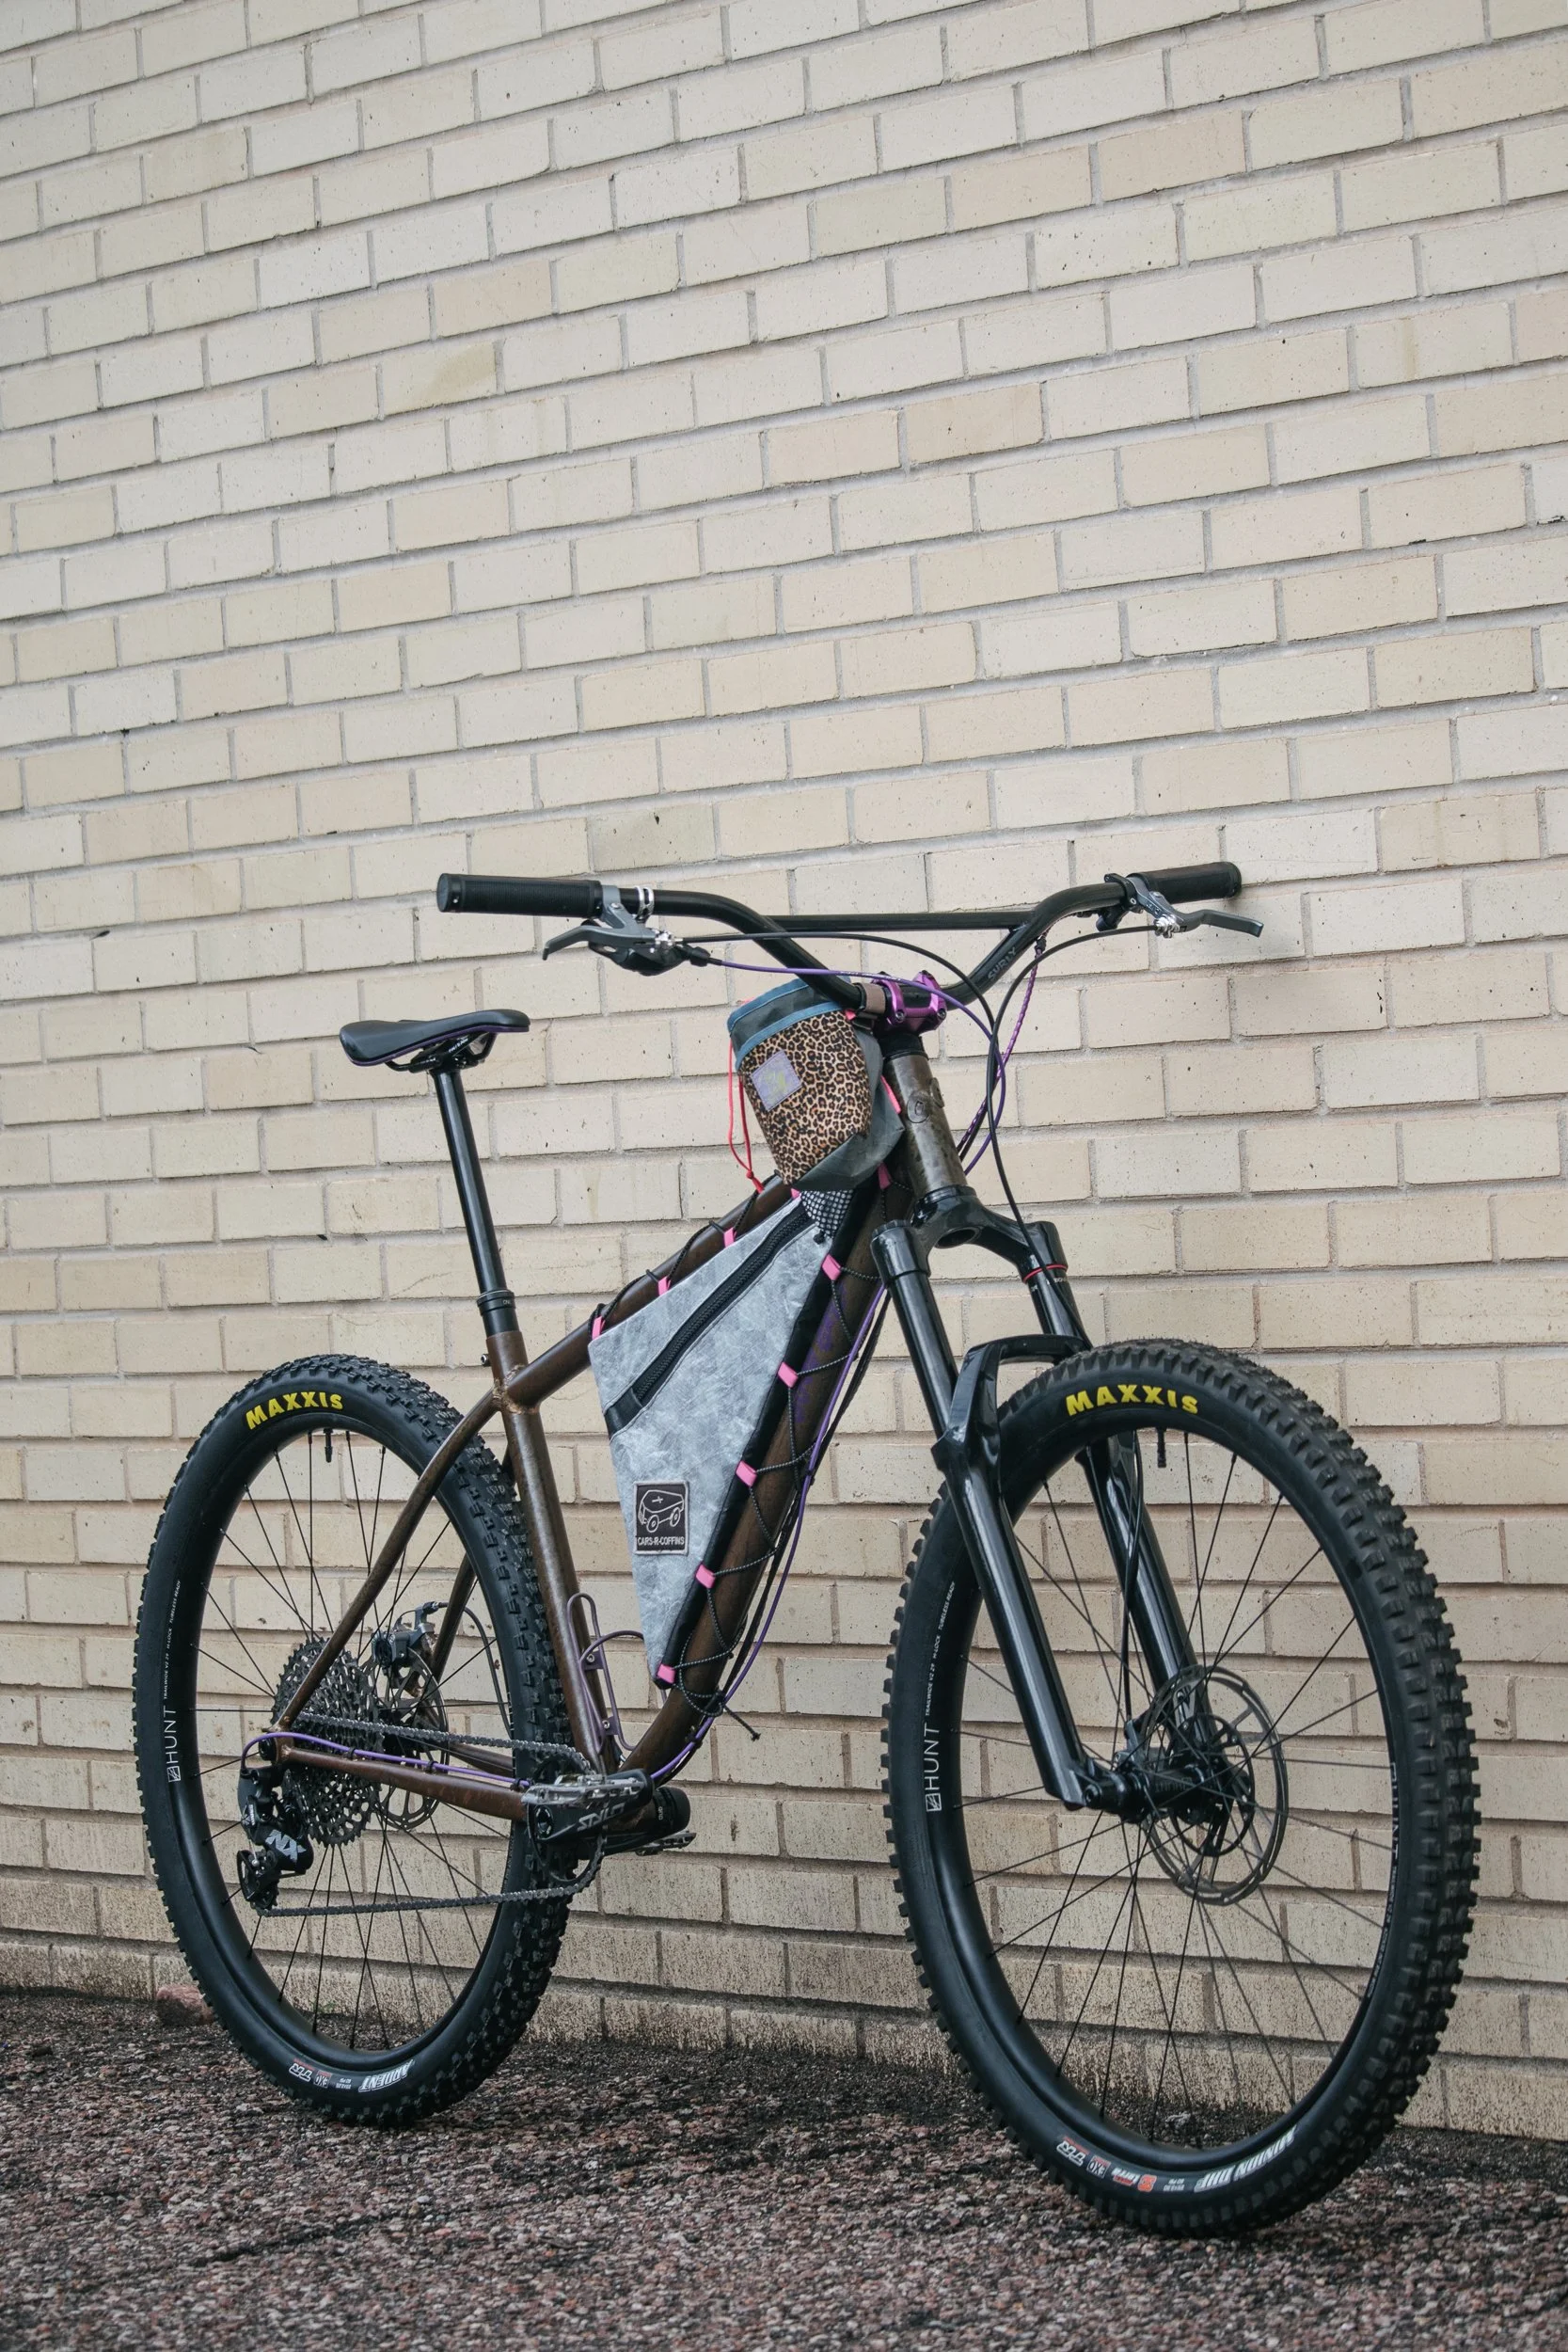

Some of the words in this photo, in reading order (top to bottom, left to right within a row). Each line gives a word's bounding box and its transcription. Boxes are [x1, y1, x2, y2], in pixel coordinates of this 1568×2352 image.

[988, 946, 1017, 979] SURLY
[245, 1391, 343, 1430] MAXXIS
[1065, 1384, 1198, 1417] MAXXIS
[637, 1536, 685, 1546] CARS-R-COFFINS
[925, 1682, 933, 1716] TRAILWIDE
[938, 1600, 950, 1630] TUBELESS
[946, 1581, 956, 1601] READY
[163, 1705, 179, 1765] HUNT
[924, 1722, 941, 1790] HUNT
[577, 1802, 626, 1833] STYLO
[264, 1829, 308, 1864] NX
[288, 2063, 313, 2083] TR
[357, 2058, 414, 2093] ARDENT
[1056, 2140, 1086, 2167] TR
